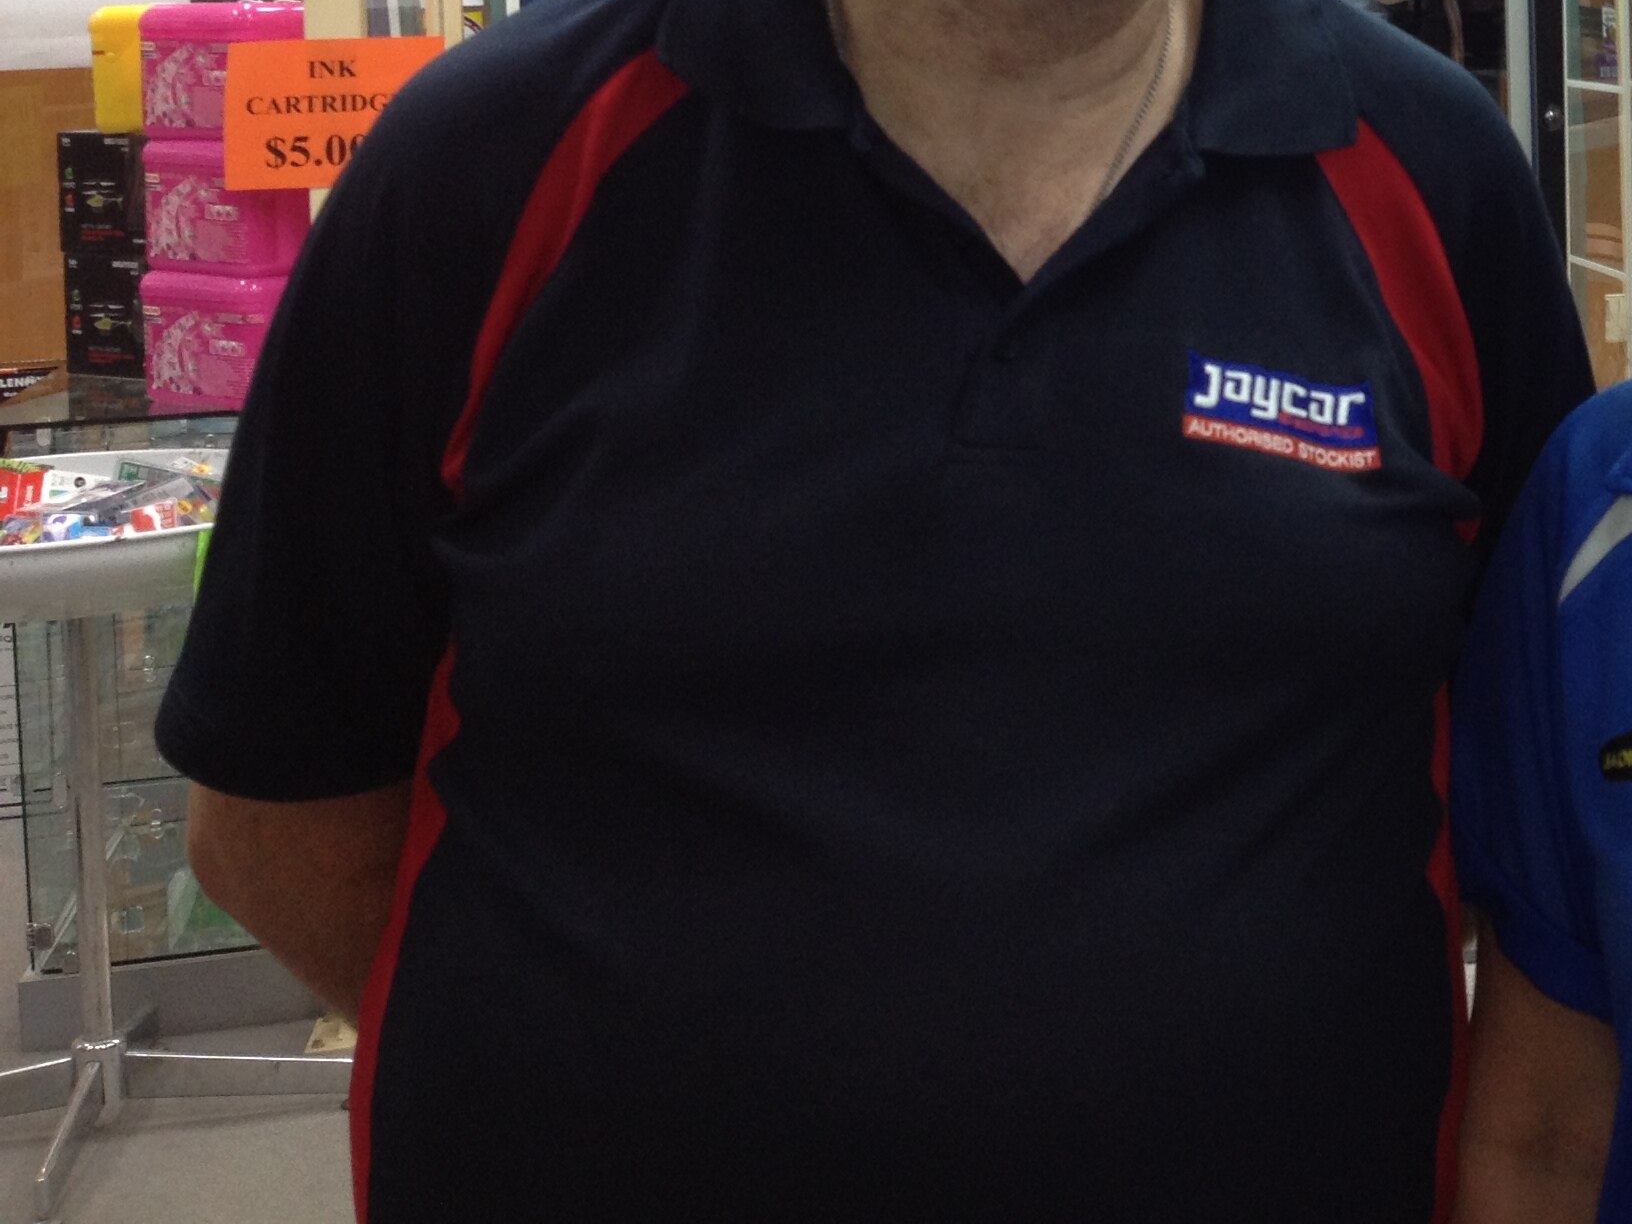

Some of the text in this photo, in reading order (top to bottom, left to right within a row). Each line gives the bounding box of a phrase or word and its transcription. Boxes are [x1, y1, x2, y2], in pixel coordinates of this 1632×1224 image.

[308, 59, 357, 79] INK
[246, 93, 395, 116] CARTRIDG
[1193, 362, 1366, 426] Jaycar
[1187, 419, 1294, 454] AUTHORISED
[1298, 441, 1377, 468] STOCKIST
